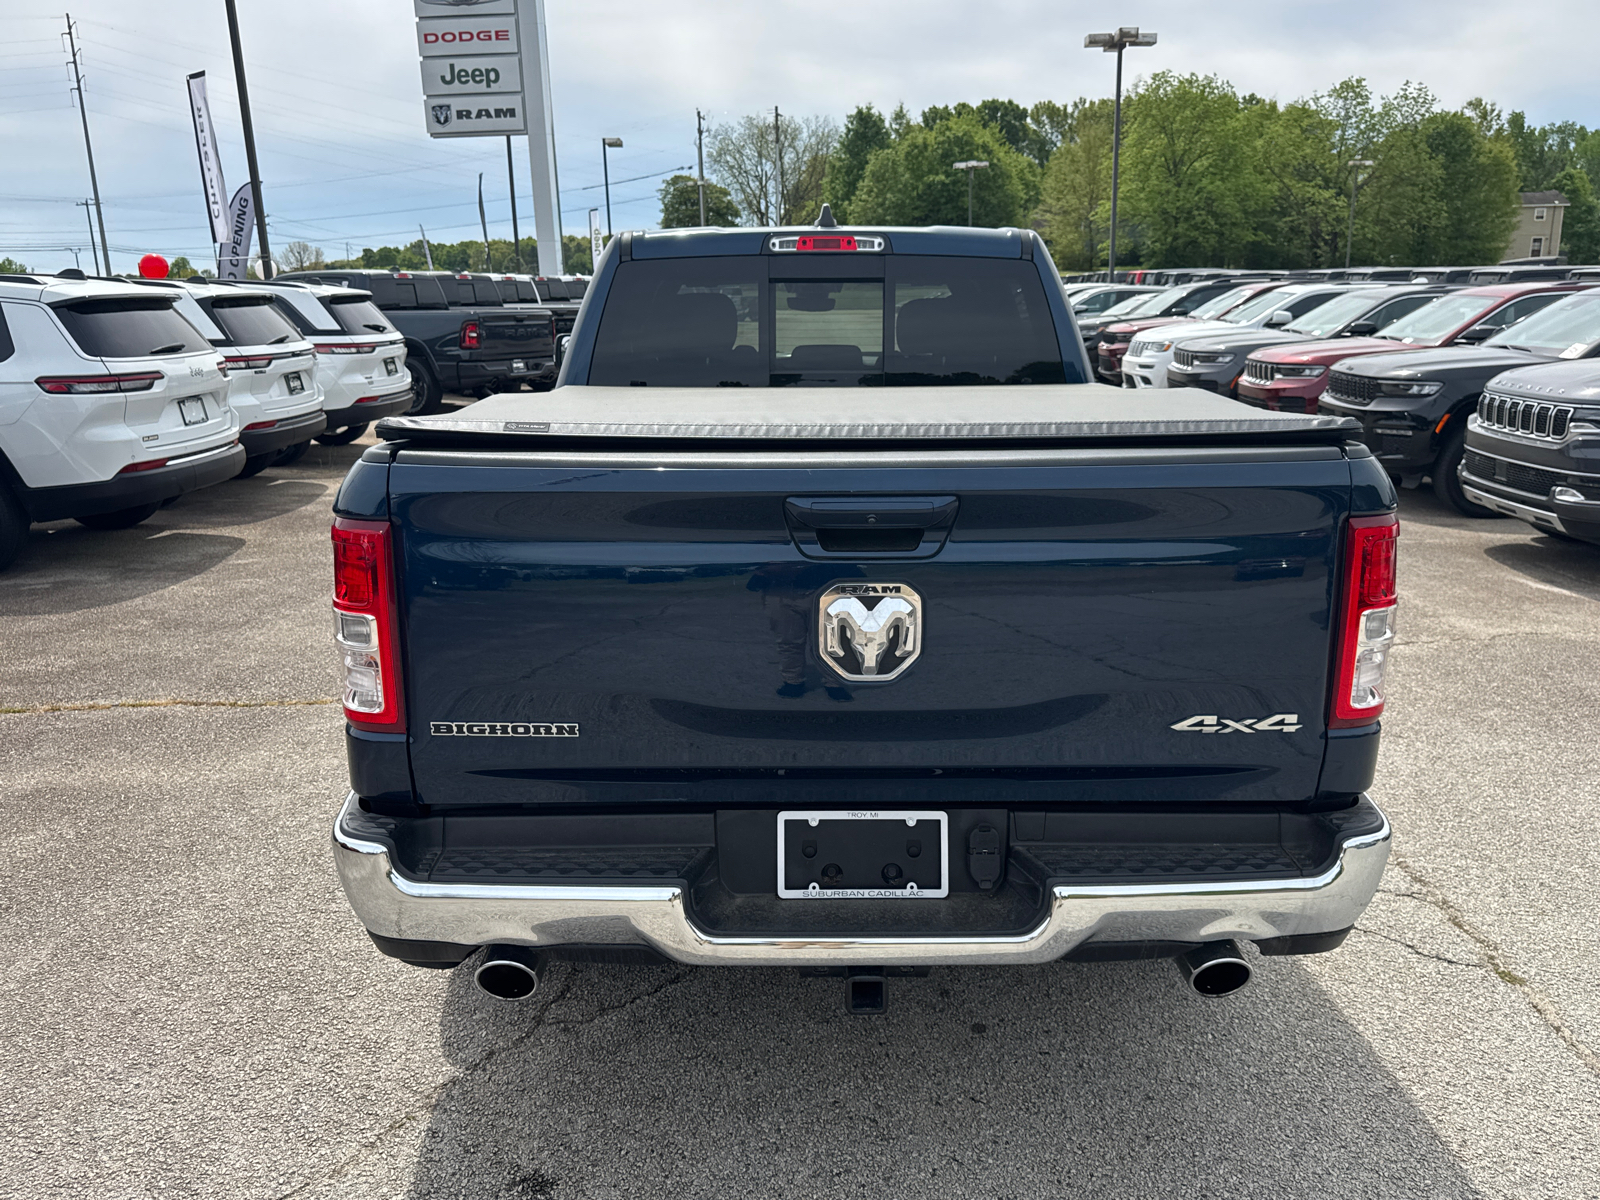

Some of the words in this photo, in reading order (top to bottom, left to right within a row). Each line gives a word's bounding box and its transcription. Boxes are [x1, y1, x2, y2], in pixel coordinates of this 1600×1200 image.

[423, 29, 510, 44] DODGE
[440, 63, 500, 88] Jeep
[455, 107, 516, 120] RAM
[196, 106, 220, 219] CHRYSLER
[229, 196, 249, 268] OPENING
[593, 228, 601, 256] Jeep
[840, 585, 902, 594] RAM
[429, 721, 580, 737] BIGHORN
[802, 890, 865, 898] SUBURBAN
